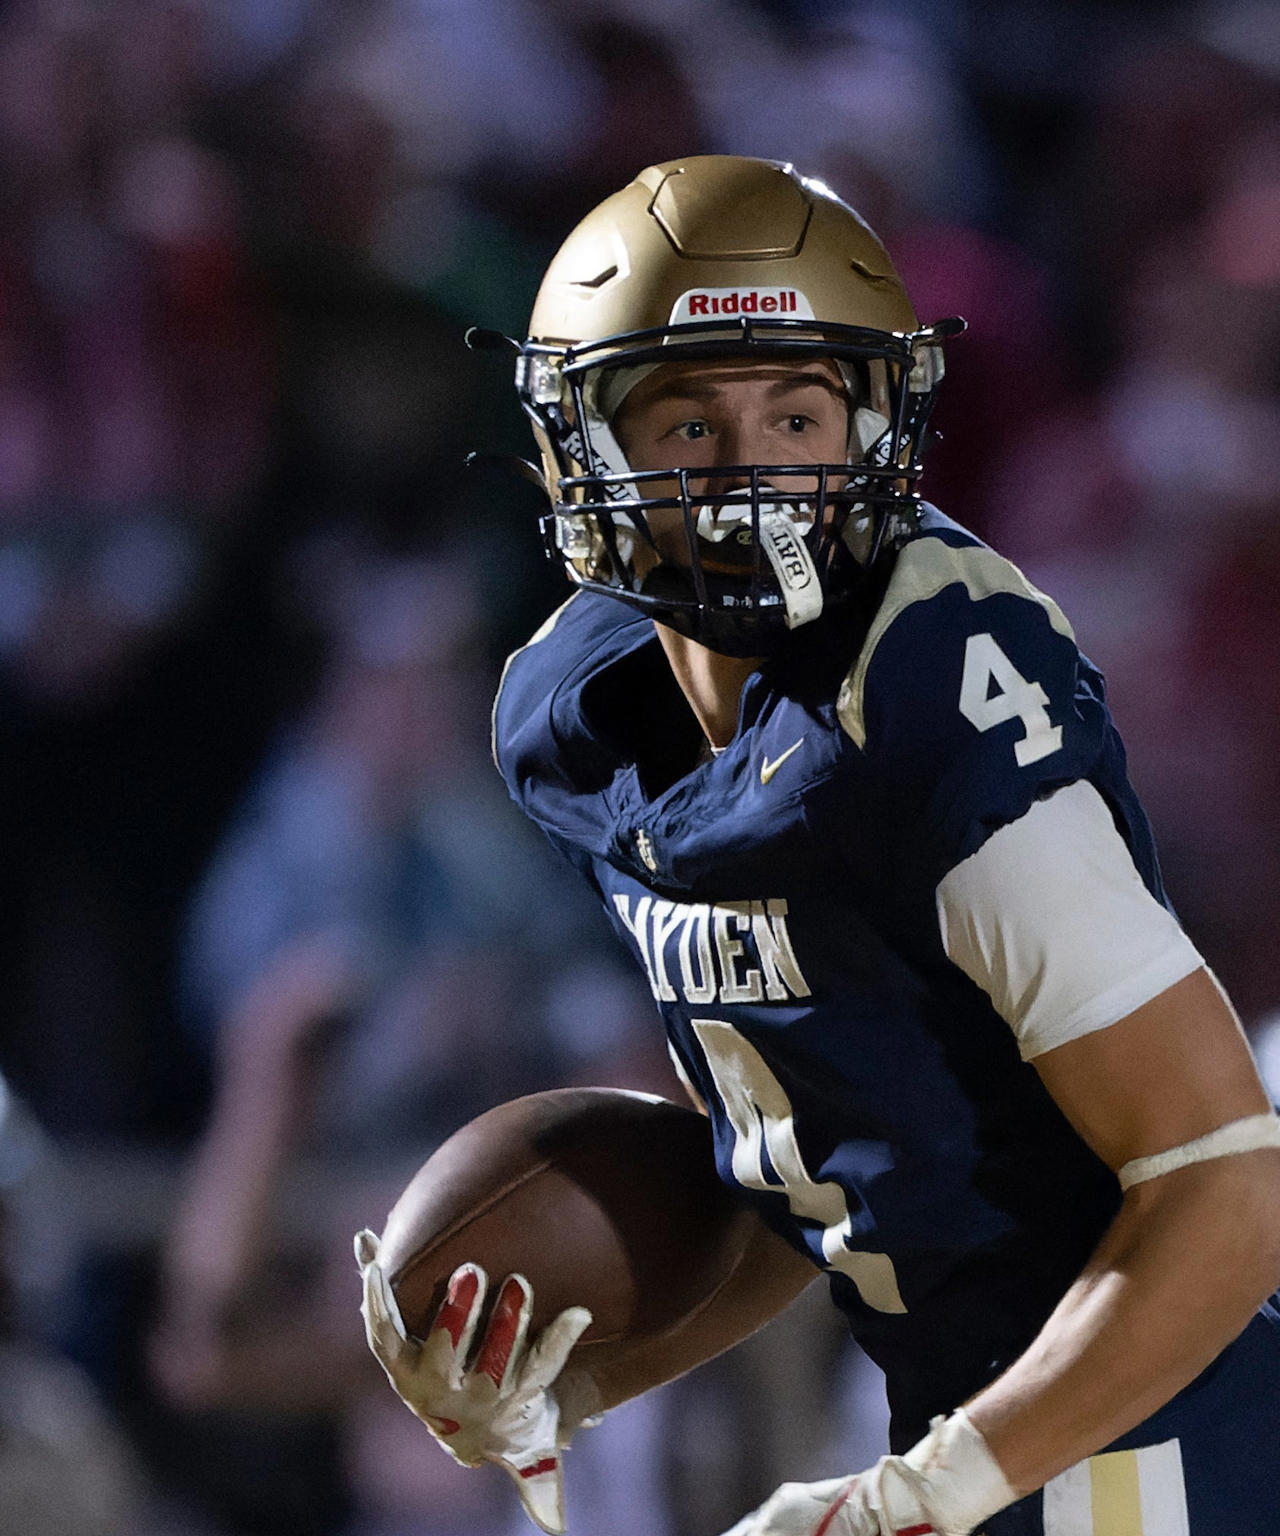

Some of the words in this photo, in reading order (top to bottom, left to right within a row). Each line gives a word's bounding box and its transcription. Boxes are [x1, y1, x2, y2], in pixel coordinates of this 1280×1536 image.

[689, 291, 797, 316] Riddell
[958, 632, 1063, 767] 4
[691, 1018, 909, 1315] 4
